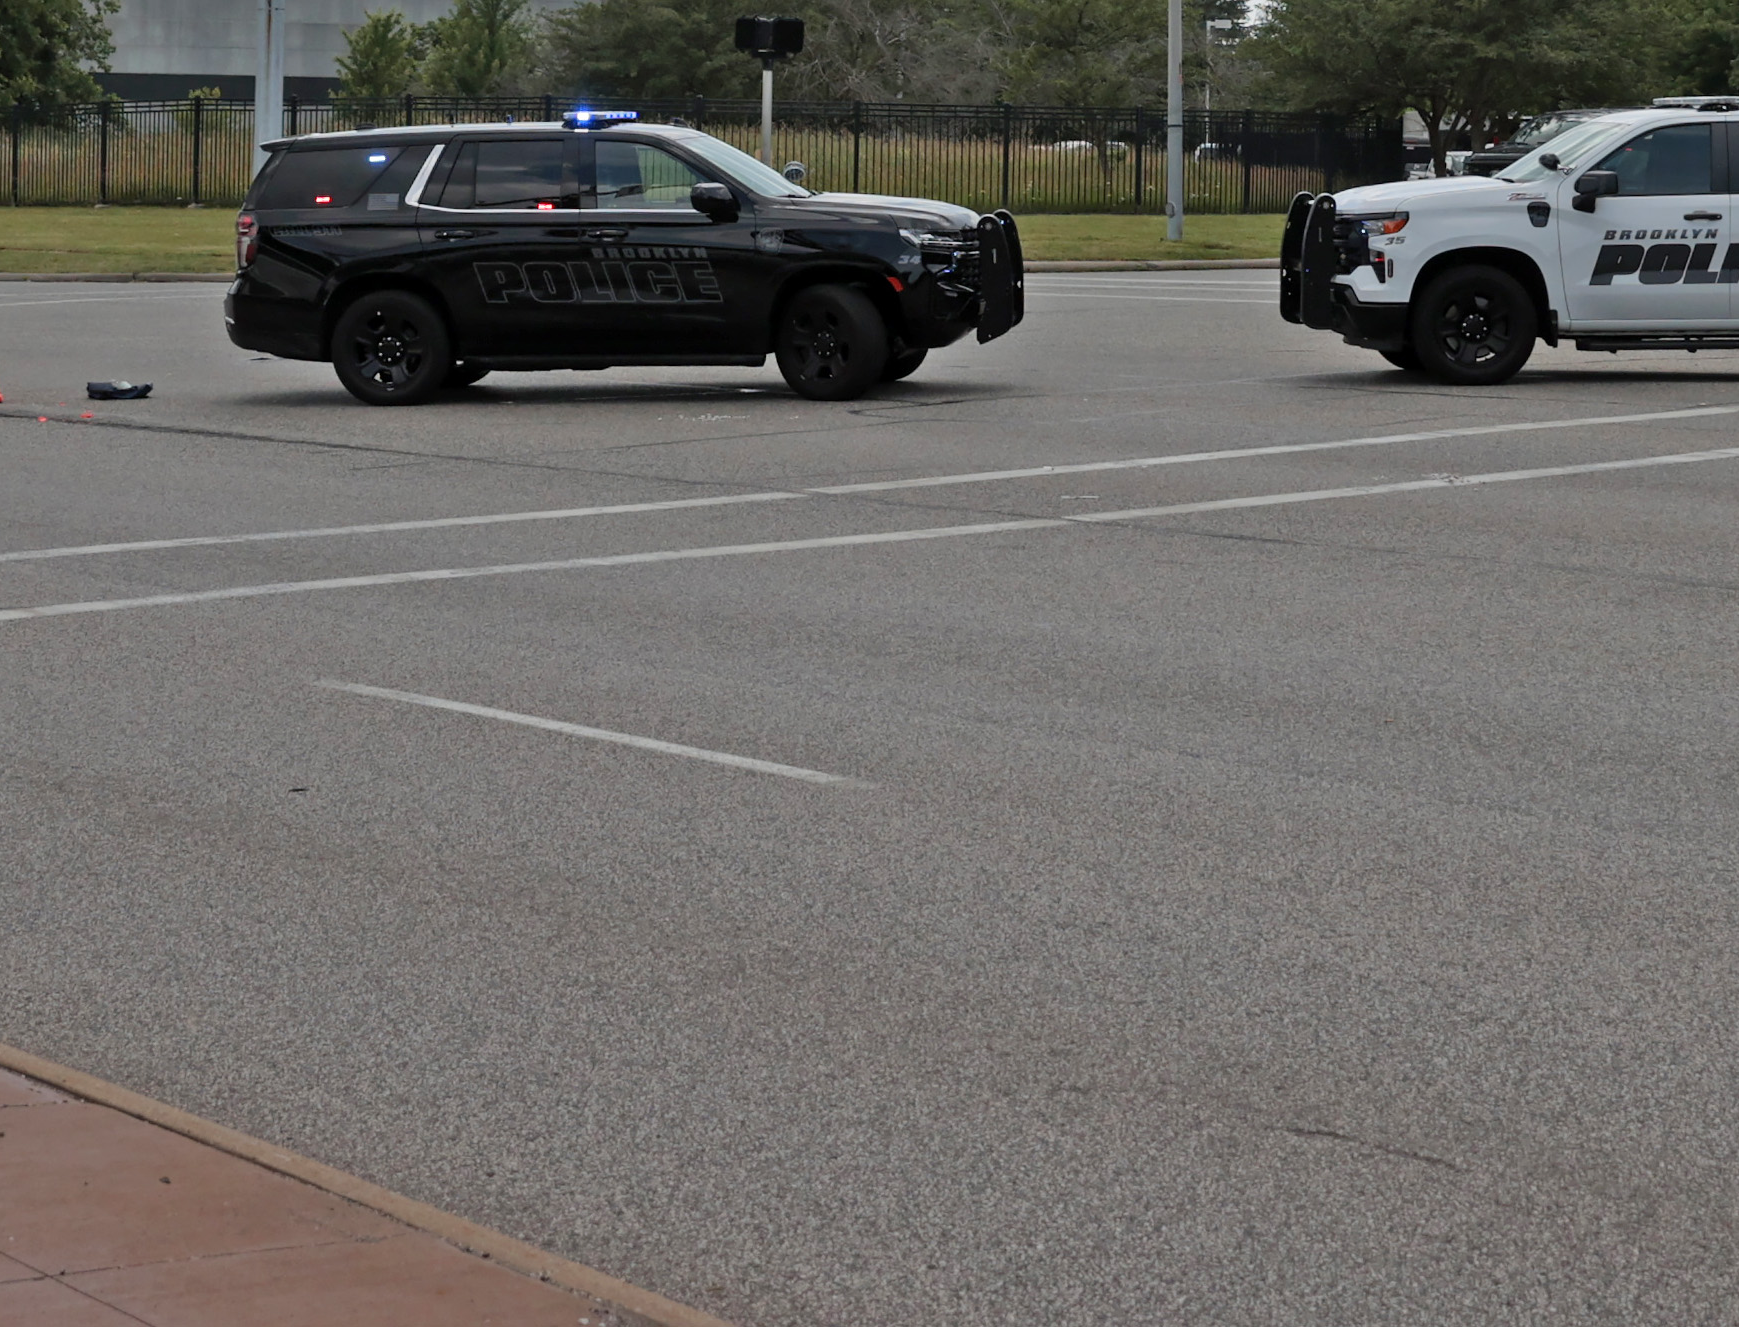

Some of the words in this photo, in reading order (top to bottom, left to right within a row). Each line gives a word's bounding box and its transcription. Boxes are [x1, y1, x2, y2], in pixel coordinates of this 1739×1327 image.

[1603, 228, 1719, 241] BROOKLYN
[1385, 236, 1407, 246] 35
[591, 247, 708, 259] BROOKLYN
[897, 254, 922, 265] 34
[472, 261, 724, 303] POLICE
